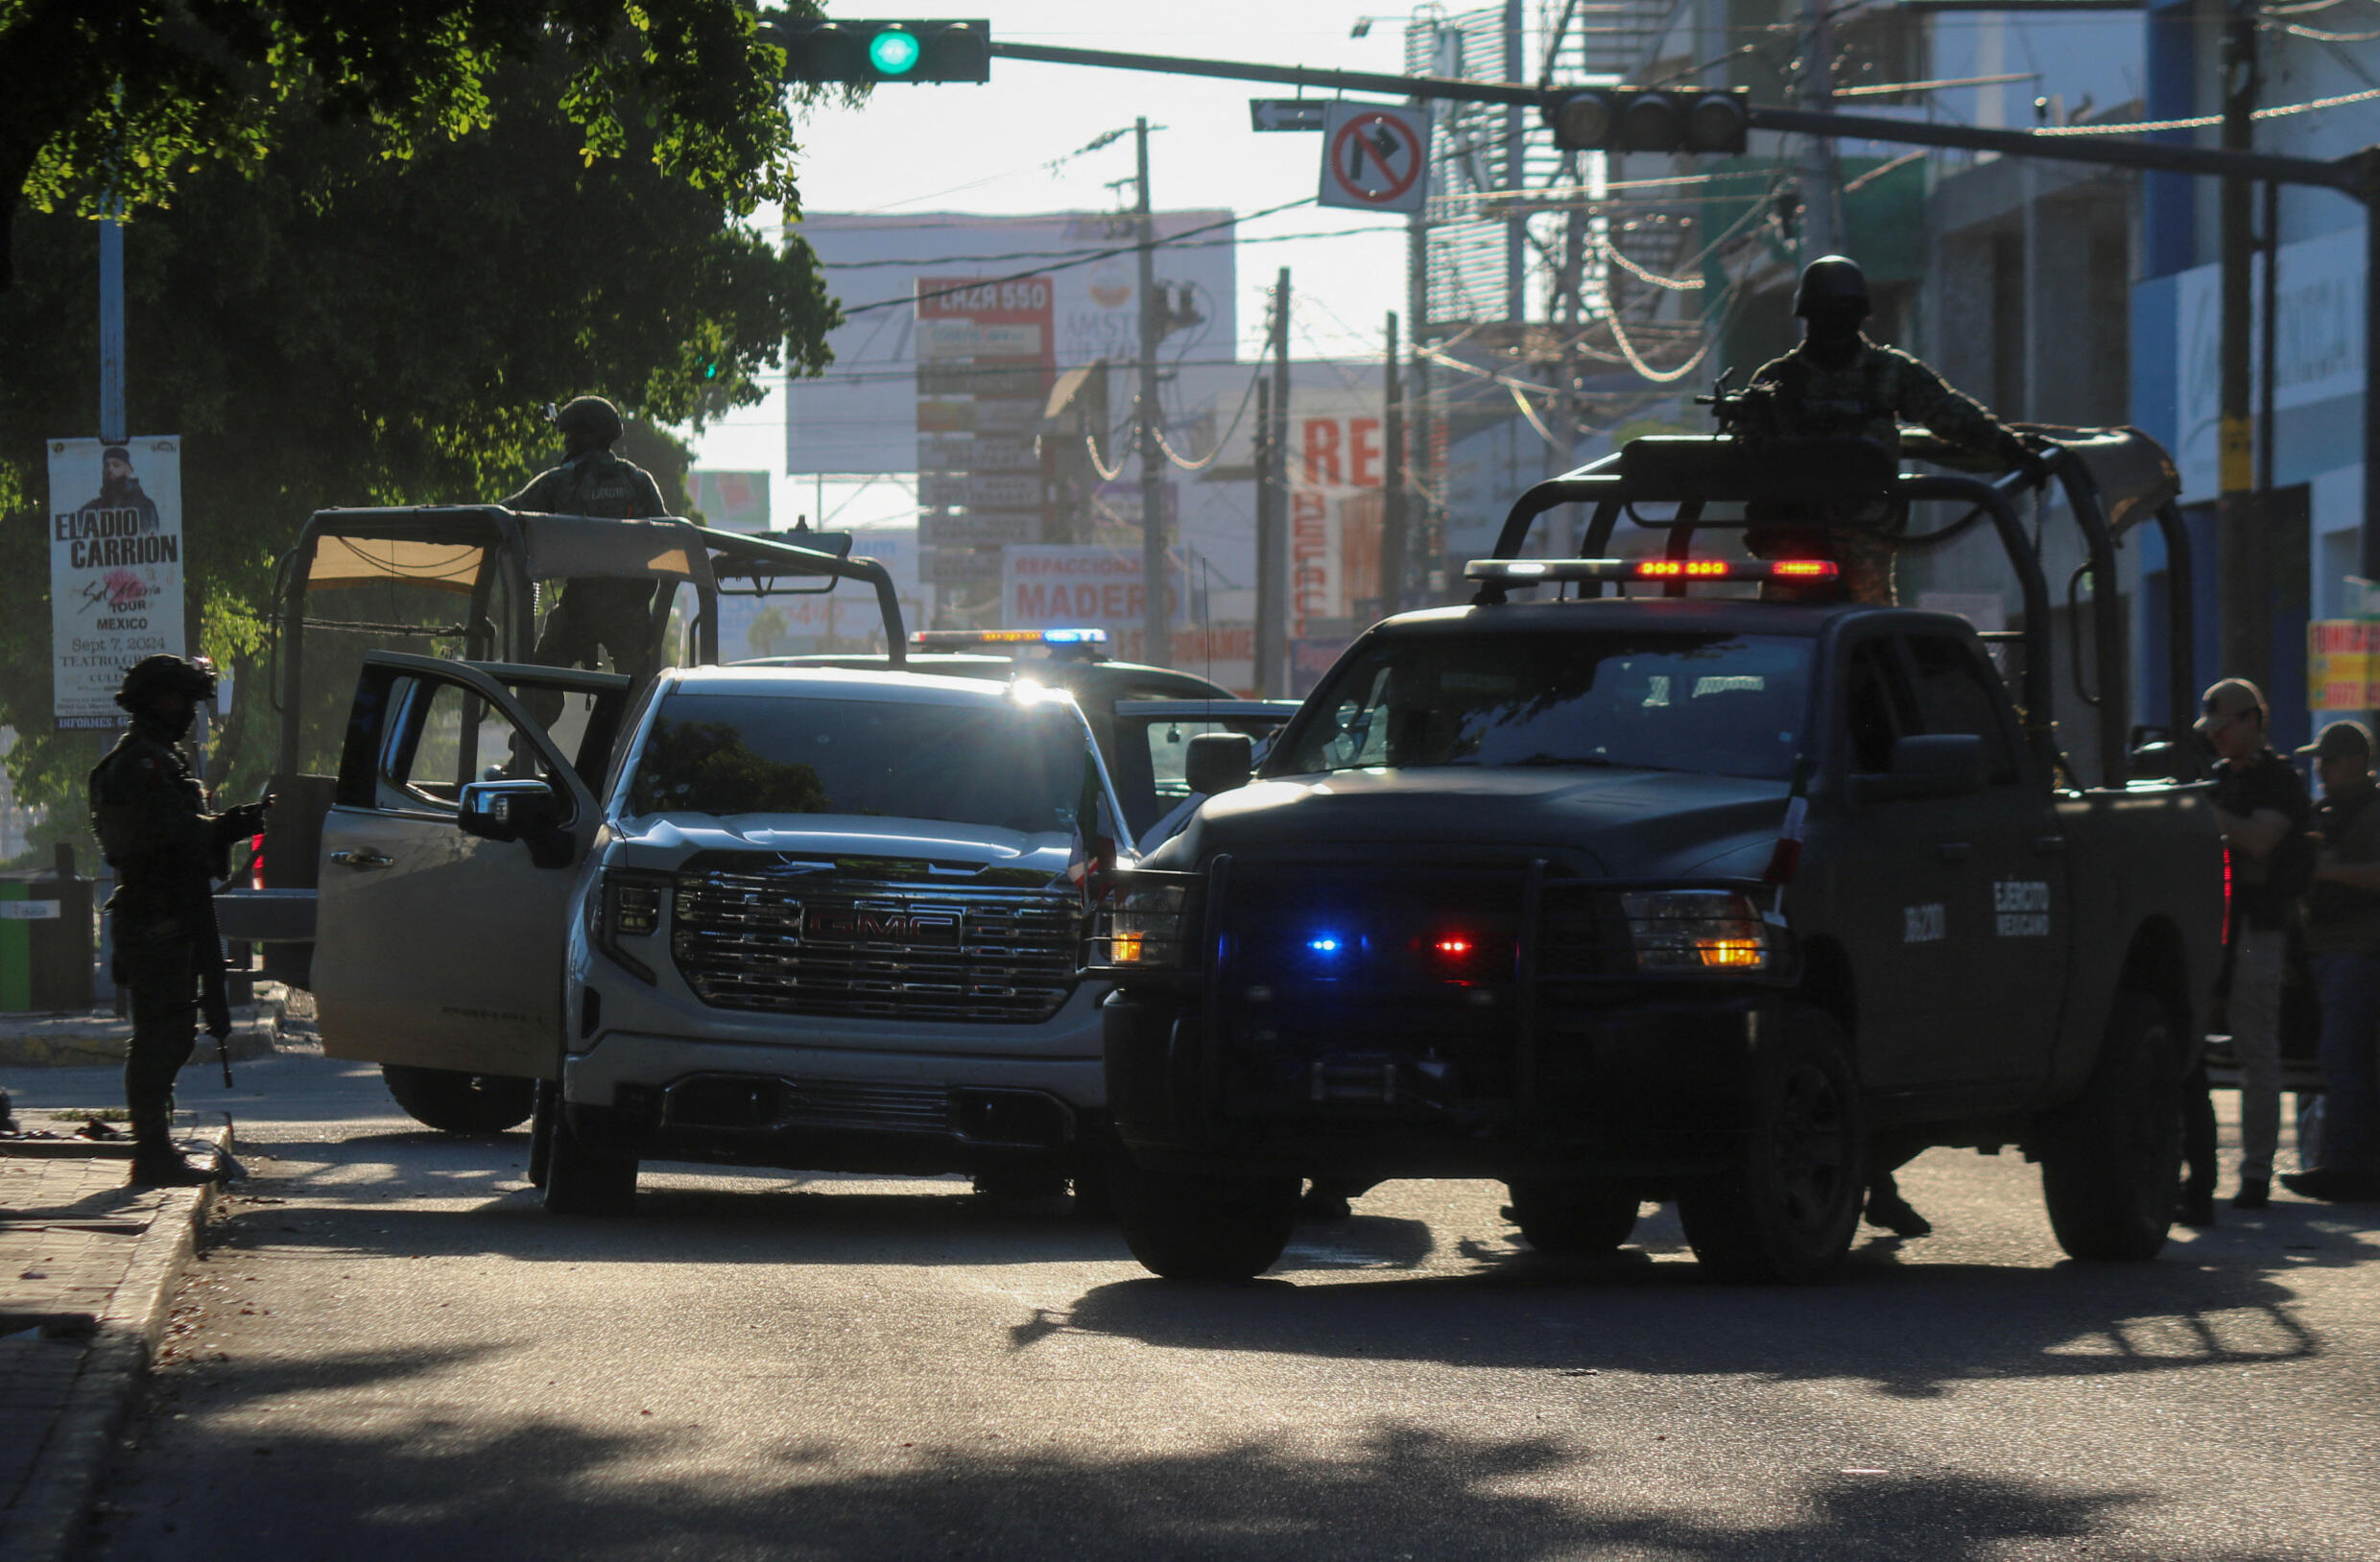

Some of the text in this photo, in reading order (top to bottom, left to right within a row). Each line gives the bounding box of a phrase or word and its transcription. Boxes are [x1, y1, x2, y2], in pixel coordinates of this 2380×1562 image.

[55, 509, 138, 541] ELADIO
[70, 532, 178, 568] CARRIÓN
[108, 601, 147, 614] TOUR
[97, 618, 148, 629] MEXICO
[71, 637, 107, 653] Sept
[127, 637, 165, 651] 2024
[810, 912, 954, 937] GMC
